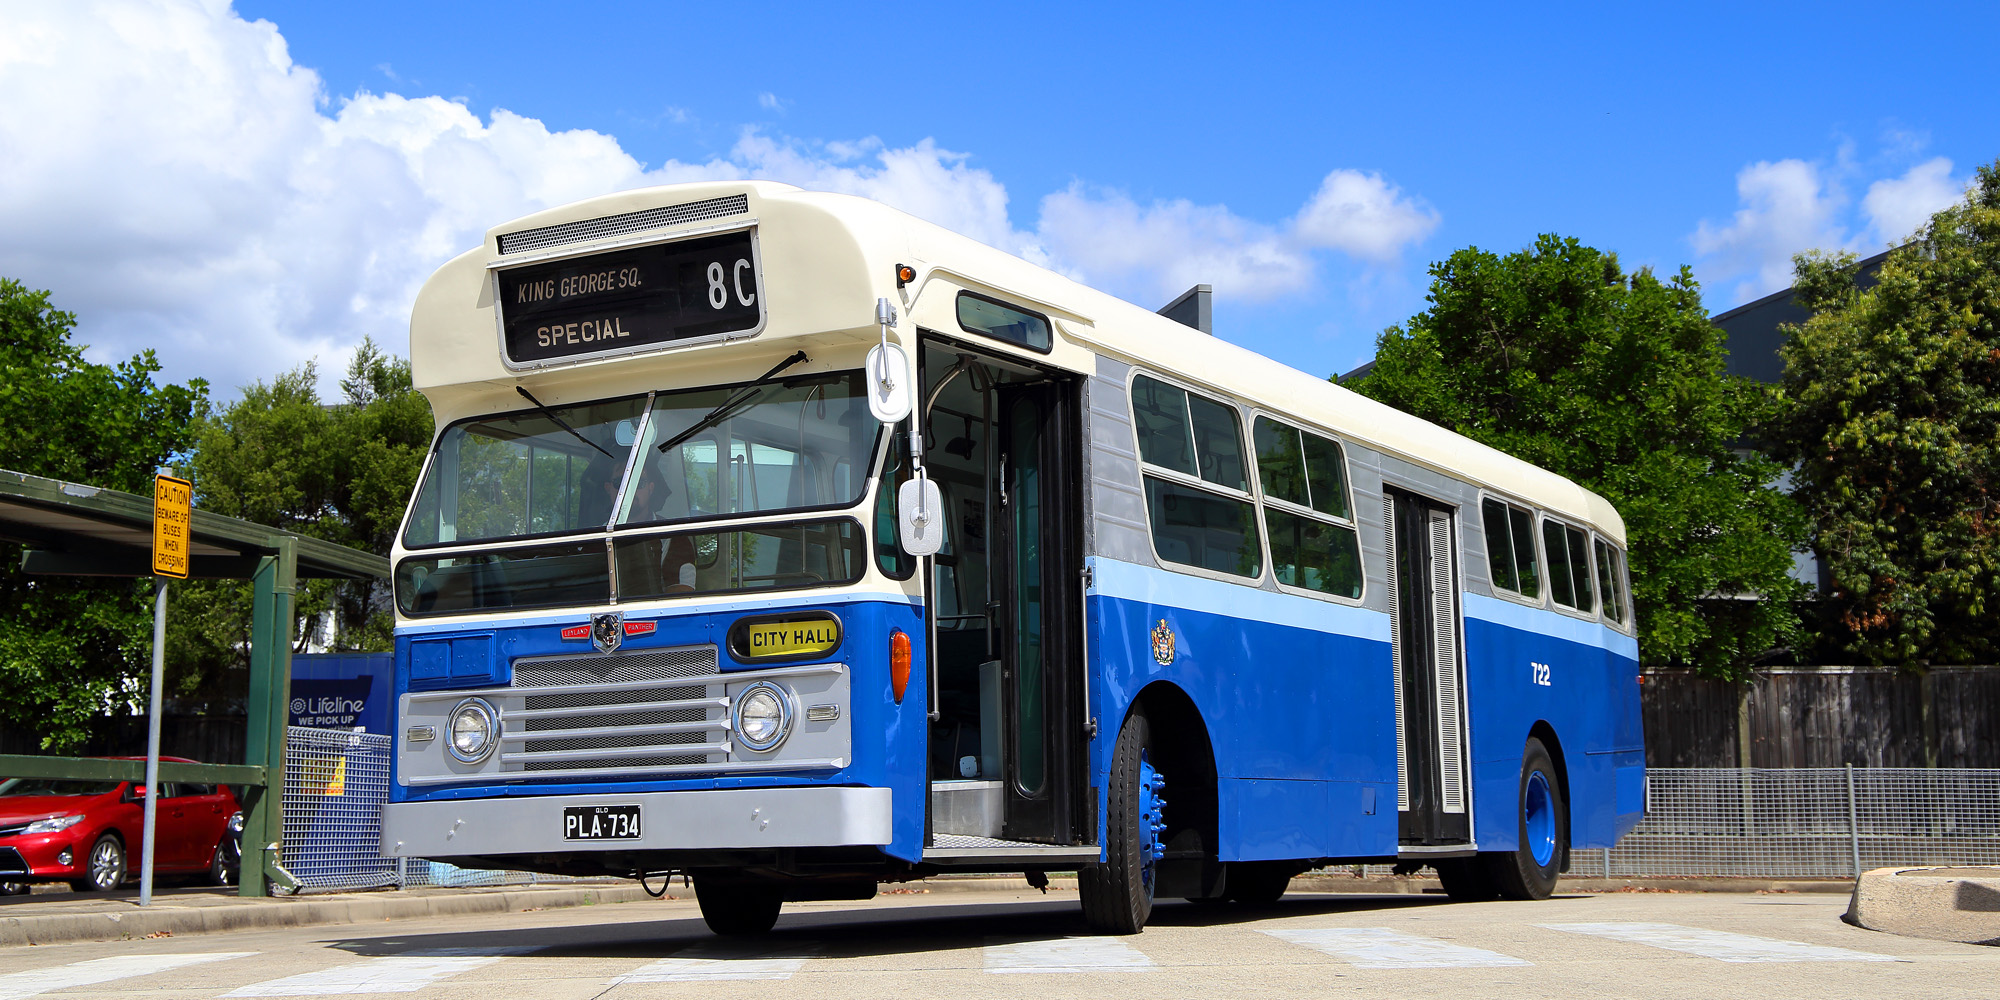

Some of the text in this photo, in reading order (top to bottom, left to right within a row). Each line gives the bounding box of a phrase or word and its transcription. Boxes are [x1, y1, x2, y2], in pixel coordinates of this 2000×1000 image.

[518, 267, 642, 304] KING GEORGE SQ.
[537, 317, 630, 347] SPECIAL
[159, 485, 188, 506] CAUTION
[158, 507, 188, 523] BEWARE OF
[163, 523, 181, 538] BUSES
[164, 538, 179, 552] WHEN
[158, 552, 184, 568] CROSSING
[563, 628, 588, 637] LEYLAND
[627, 623, 653, 631] PANTHER
[753, 628, 835, 647] CITY HALL
[1530, 661, 1552, 687] 722
[308, 697, 365, 715] Lifeline
[298, 715, 355, 726] WE PICK UP
